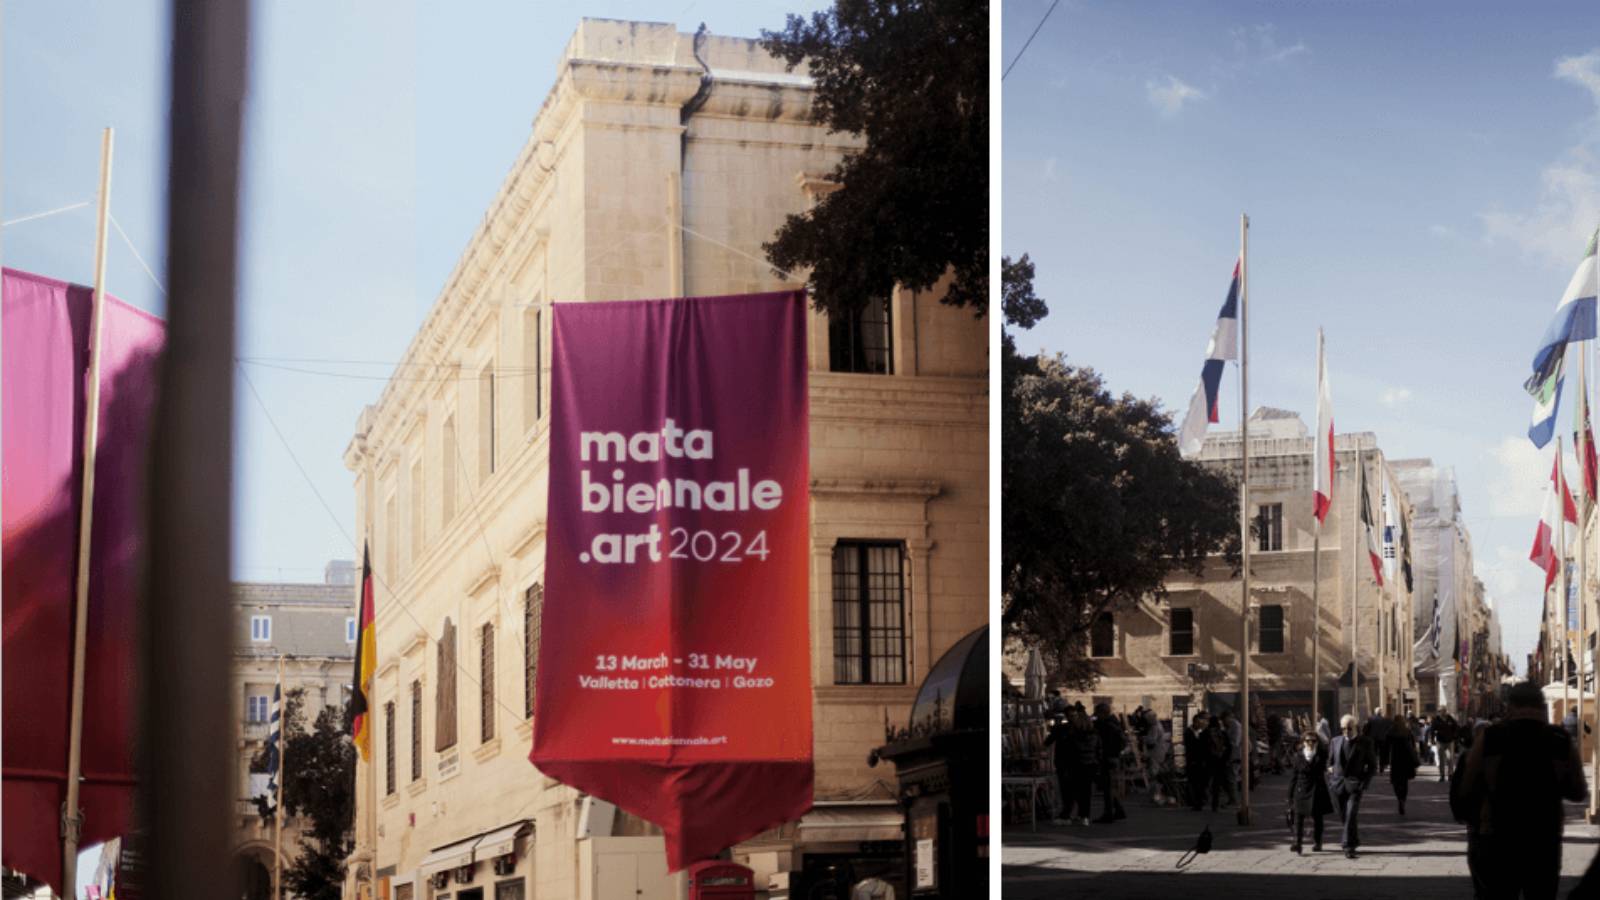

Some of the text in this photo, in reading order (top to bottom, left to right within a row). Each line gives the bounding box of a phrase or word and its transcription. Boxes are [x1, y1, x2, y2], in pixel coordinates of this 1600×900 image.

[580, 467, 783, 513] biennale
[578, 523, 771, 564] .art 2024
[595, 654, 618, 671] 13
[621, 652, 669, 671] March
[687, 653, 710, 670] 31
[714, 654, 758, 673] May
[578, 674, 639, 689] Valletta
[648, 675, 721, 689] Cottonera
[732, 675, 775, 689] Gozo
